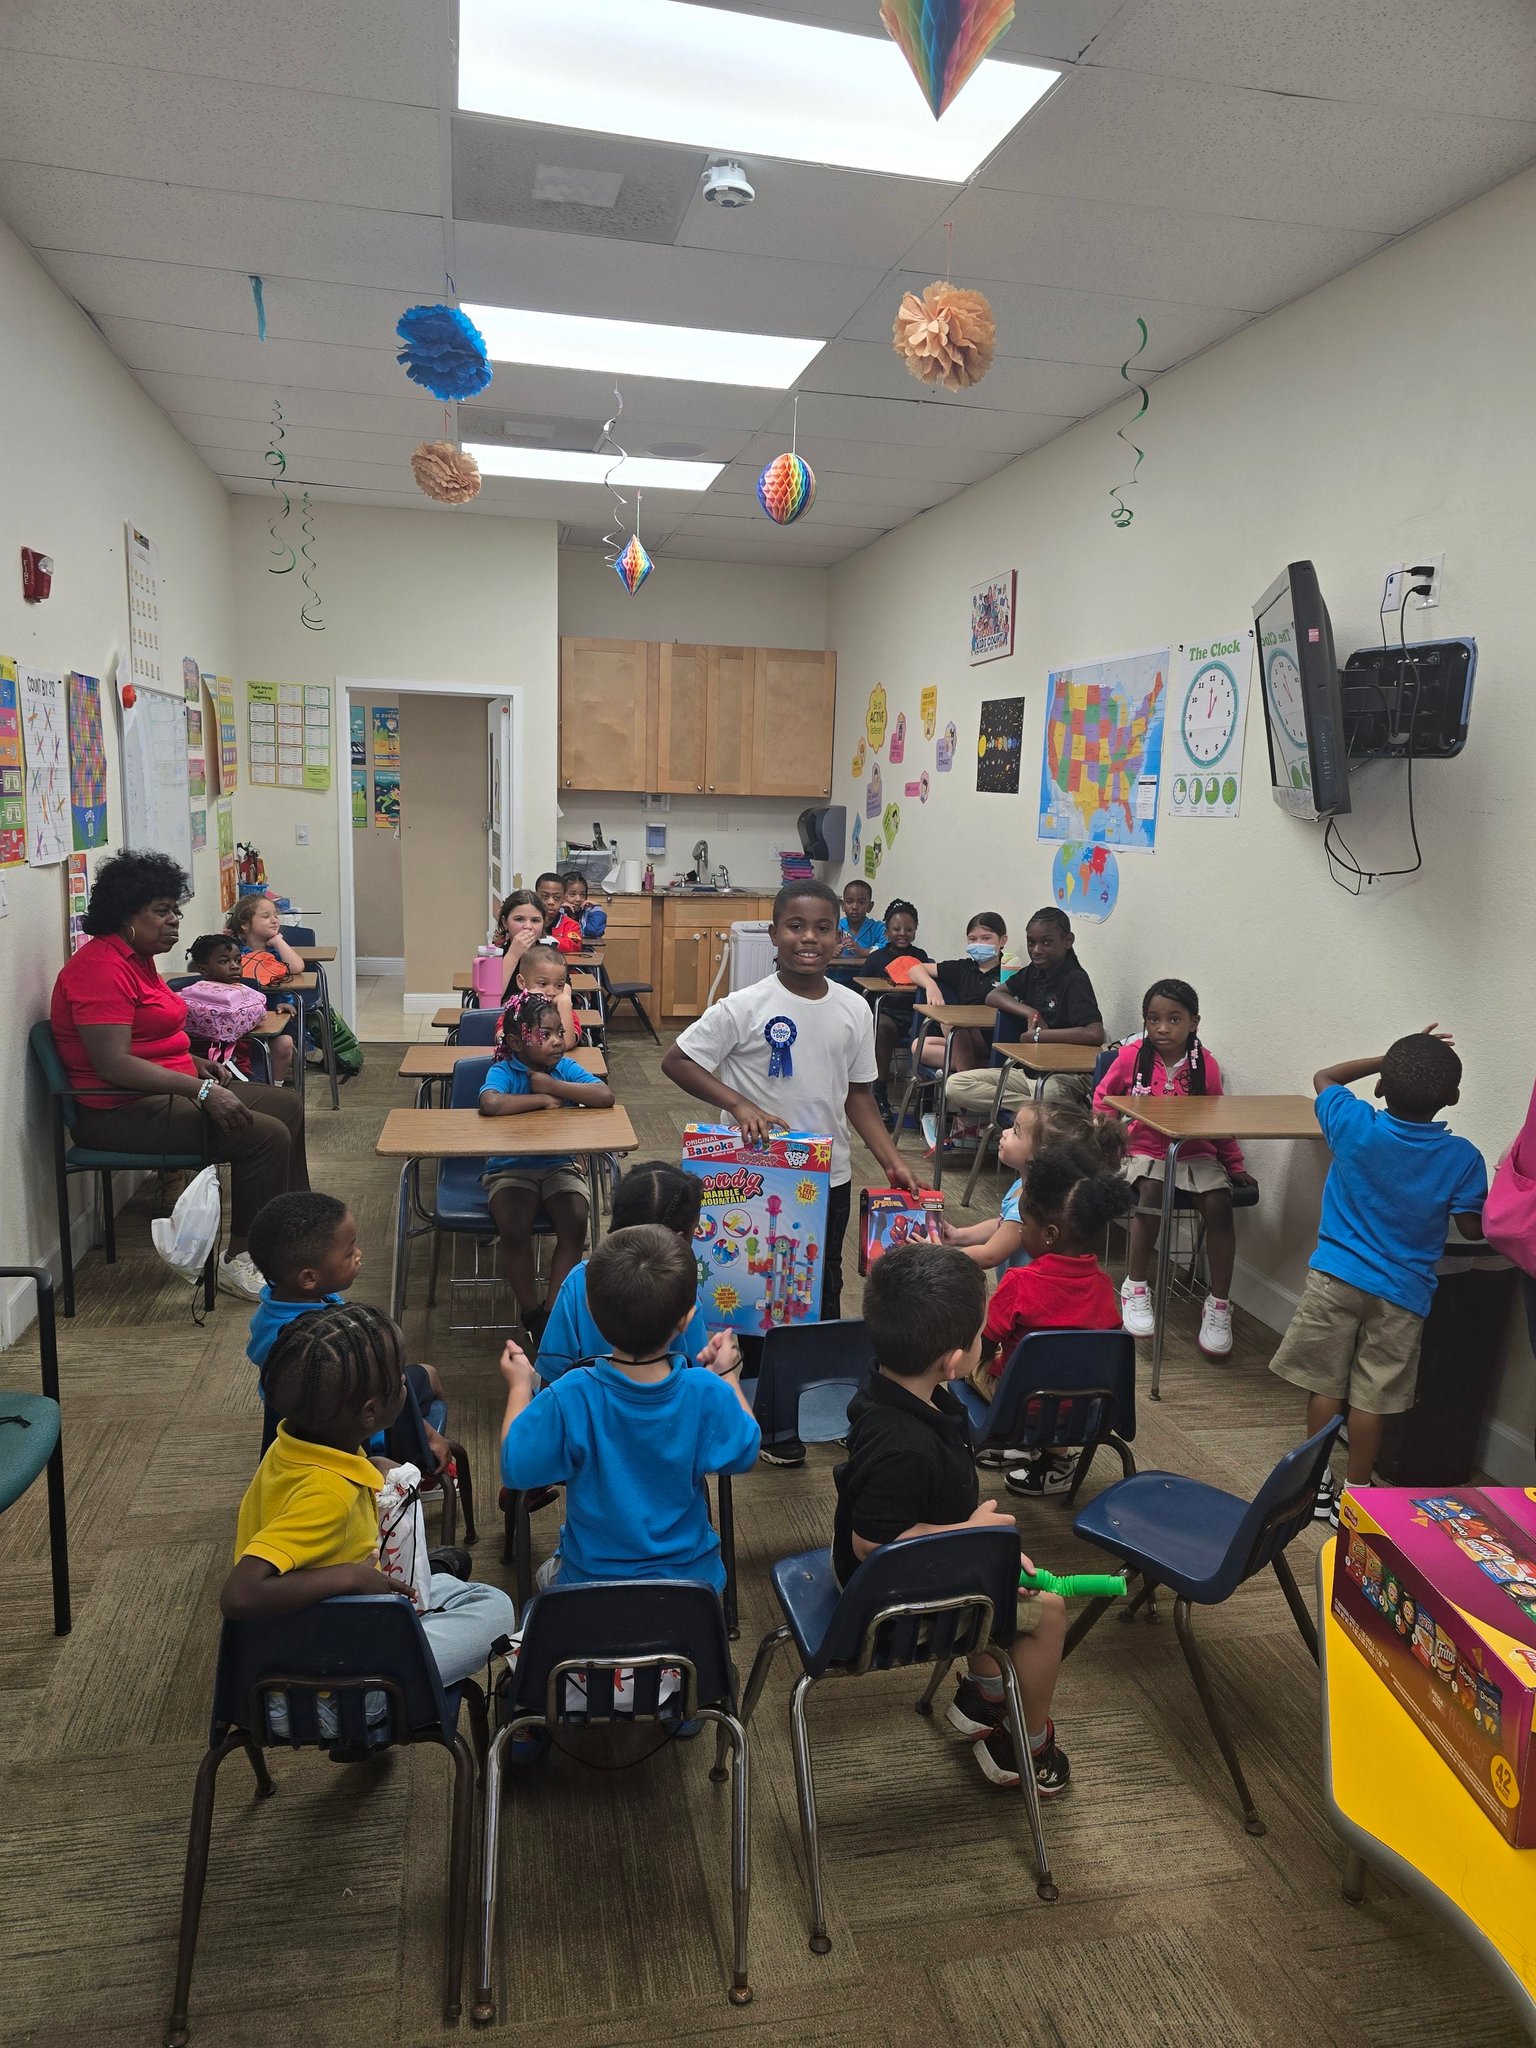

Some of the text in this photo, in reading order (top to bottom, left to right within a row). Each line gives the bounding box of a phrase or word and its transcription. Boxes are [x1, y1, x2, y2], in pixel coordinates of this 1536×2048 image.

[1188, 640, 1240, 662] The Clock
[26, 676, 41, 695] COUNT
[381, 712, 400, 720] zoolog
[869, 710, 885, 724] ACTIVE
[685, 1135, 719, 1146] ORIGINAL
[687, 1142, 734, 1156] Bazooka
[784, 1151, 810, 1161] PUSH
[789, 1158, 807, 1167] POP
[702, 1168, 763, 1198] andy
[700, 1195, 748, 1206] MOUNTAIN
[704, 1188, 740, 1199] MARBLE
[1436, 1640, 1456, 1664] Fritos
[1459, 1665, 1478, 1691] Doritos
[1480, 1690, 1499, 1710] Doritos
[1495, 1763, 1512, 1794] 42
